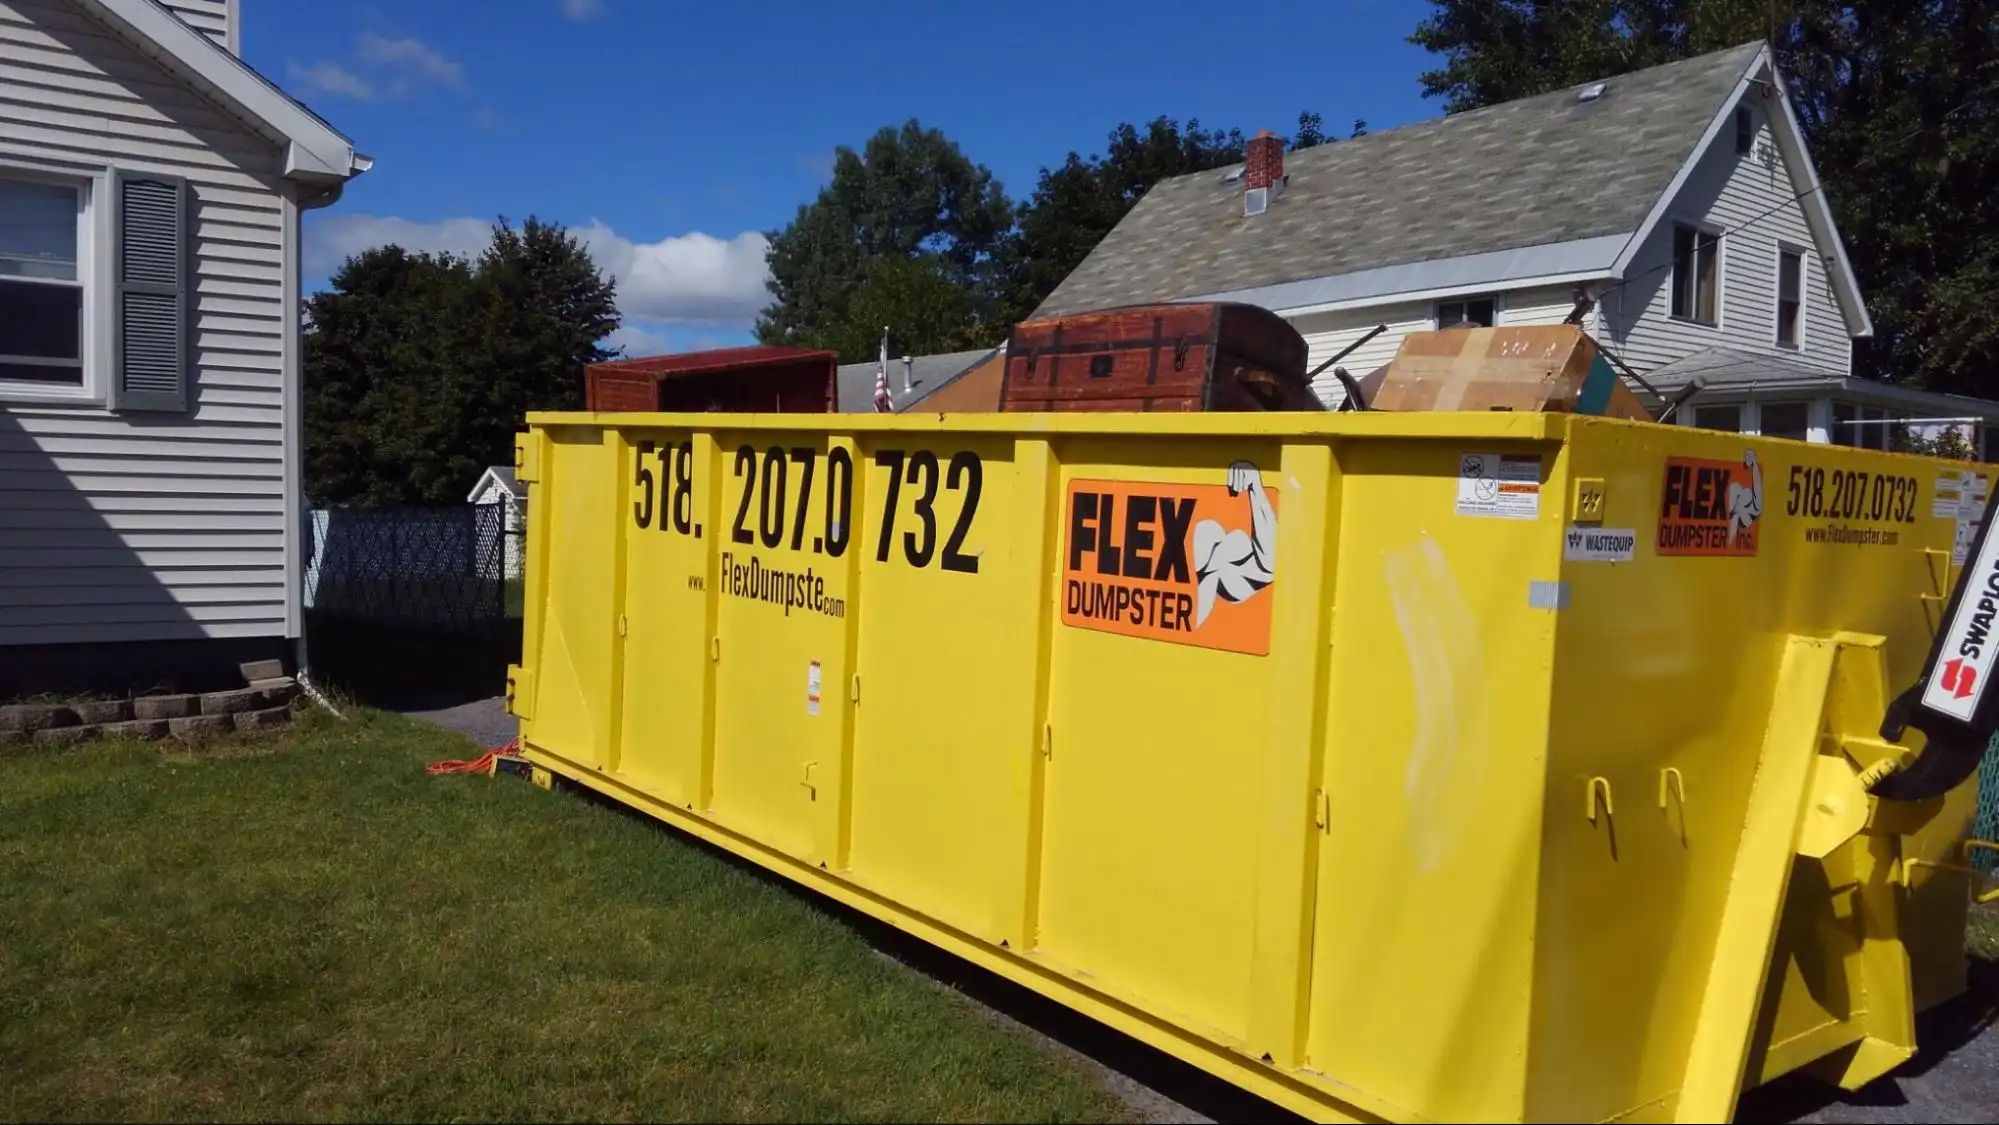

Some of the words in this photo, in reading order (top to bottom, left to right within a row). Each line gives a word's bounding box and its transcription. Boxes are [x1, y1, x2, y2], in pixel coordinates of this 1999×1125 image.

[1663, 465, 1731, 520] FLEX
[1787, 465, 1917, 523] 518.207.0732
[1069, 491, 1198, 584] FLEX
[1586, 534, 1634, 553] WASTEQUIP
[1659, 524, 1728, 549] DUMPSTER
[1067, 579, 1193, 632] DUMPSTER
